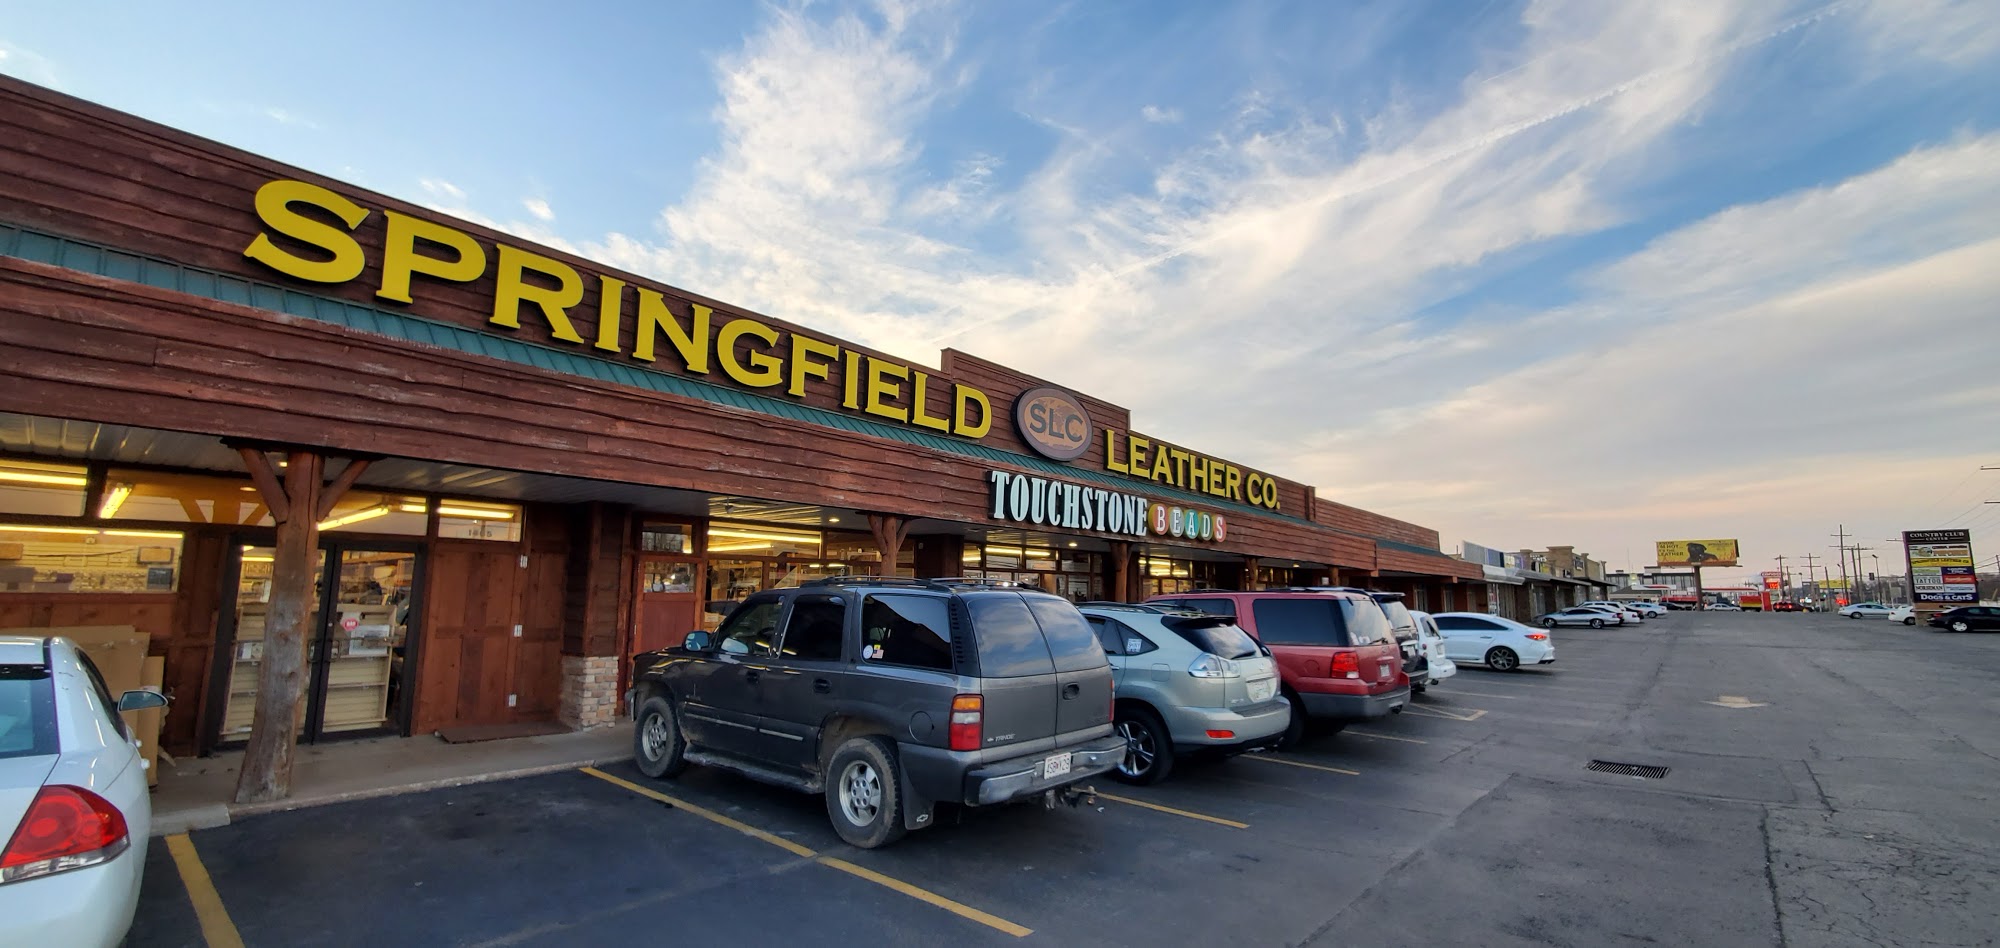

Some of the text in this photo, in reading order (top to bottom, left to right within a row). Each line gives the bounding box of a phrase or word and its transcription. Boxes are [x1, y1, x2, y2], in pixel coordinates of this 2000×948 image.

[243, 180, 993, 439] SPRINGFIELD
[1029, 403, 1084, 443] SLC
[1106, 429, 1281, 510] LEATHER CO.
[991, 470, 1148, 536] TOUCHSTONE
[1154, 503, 1225, 541] BEADS
